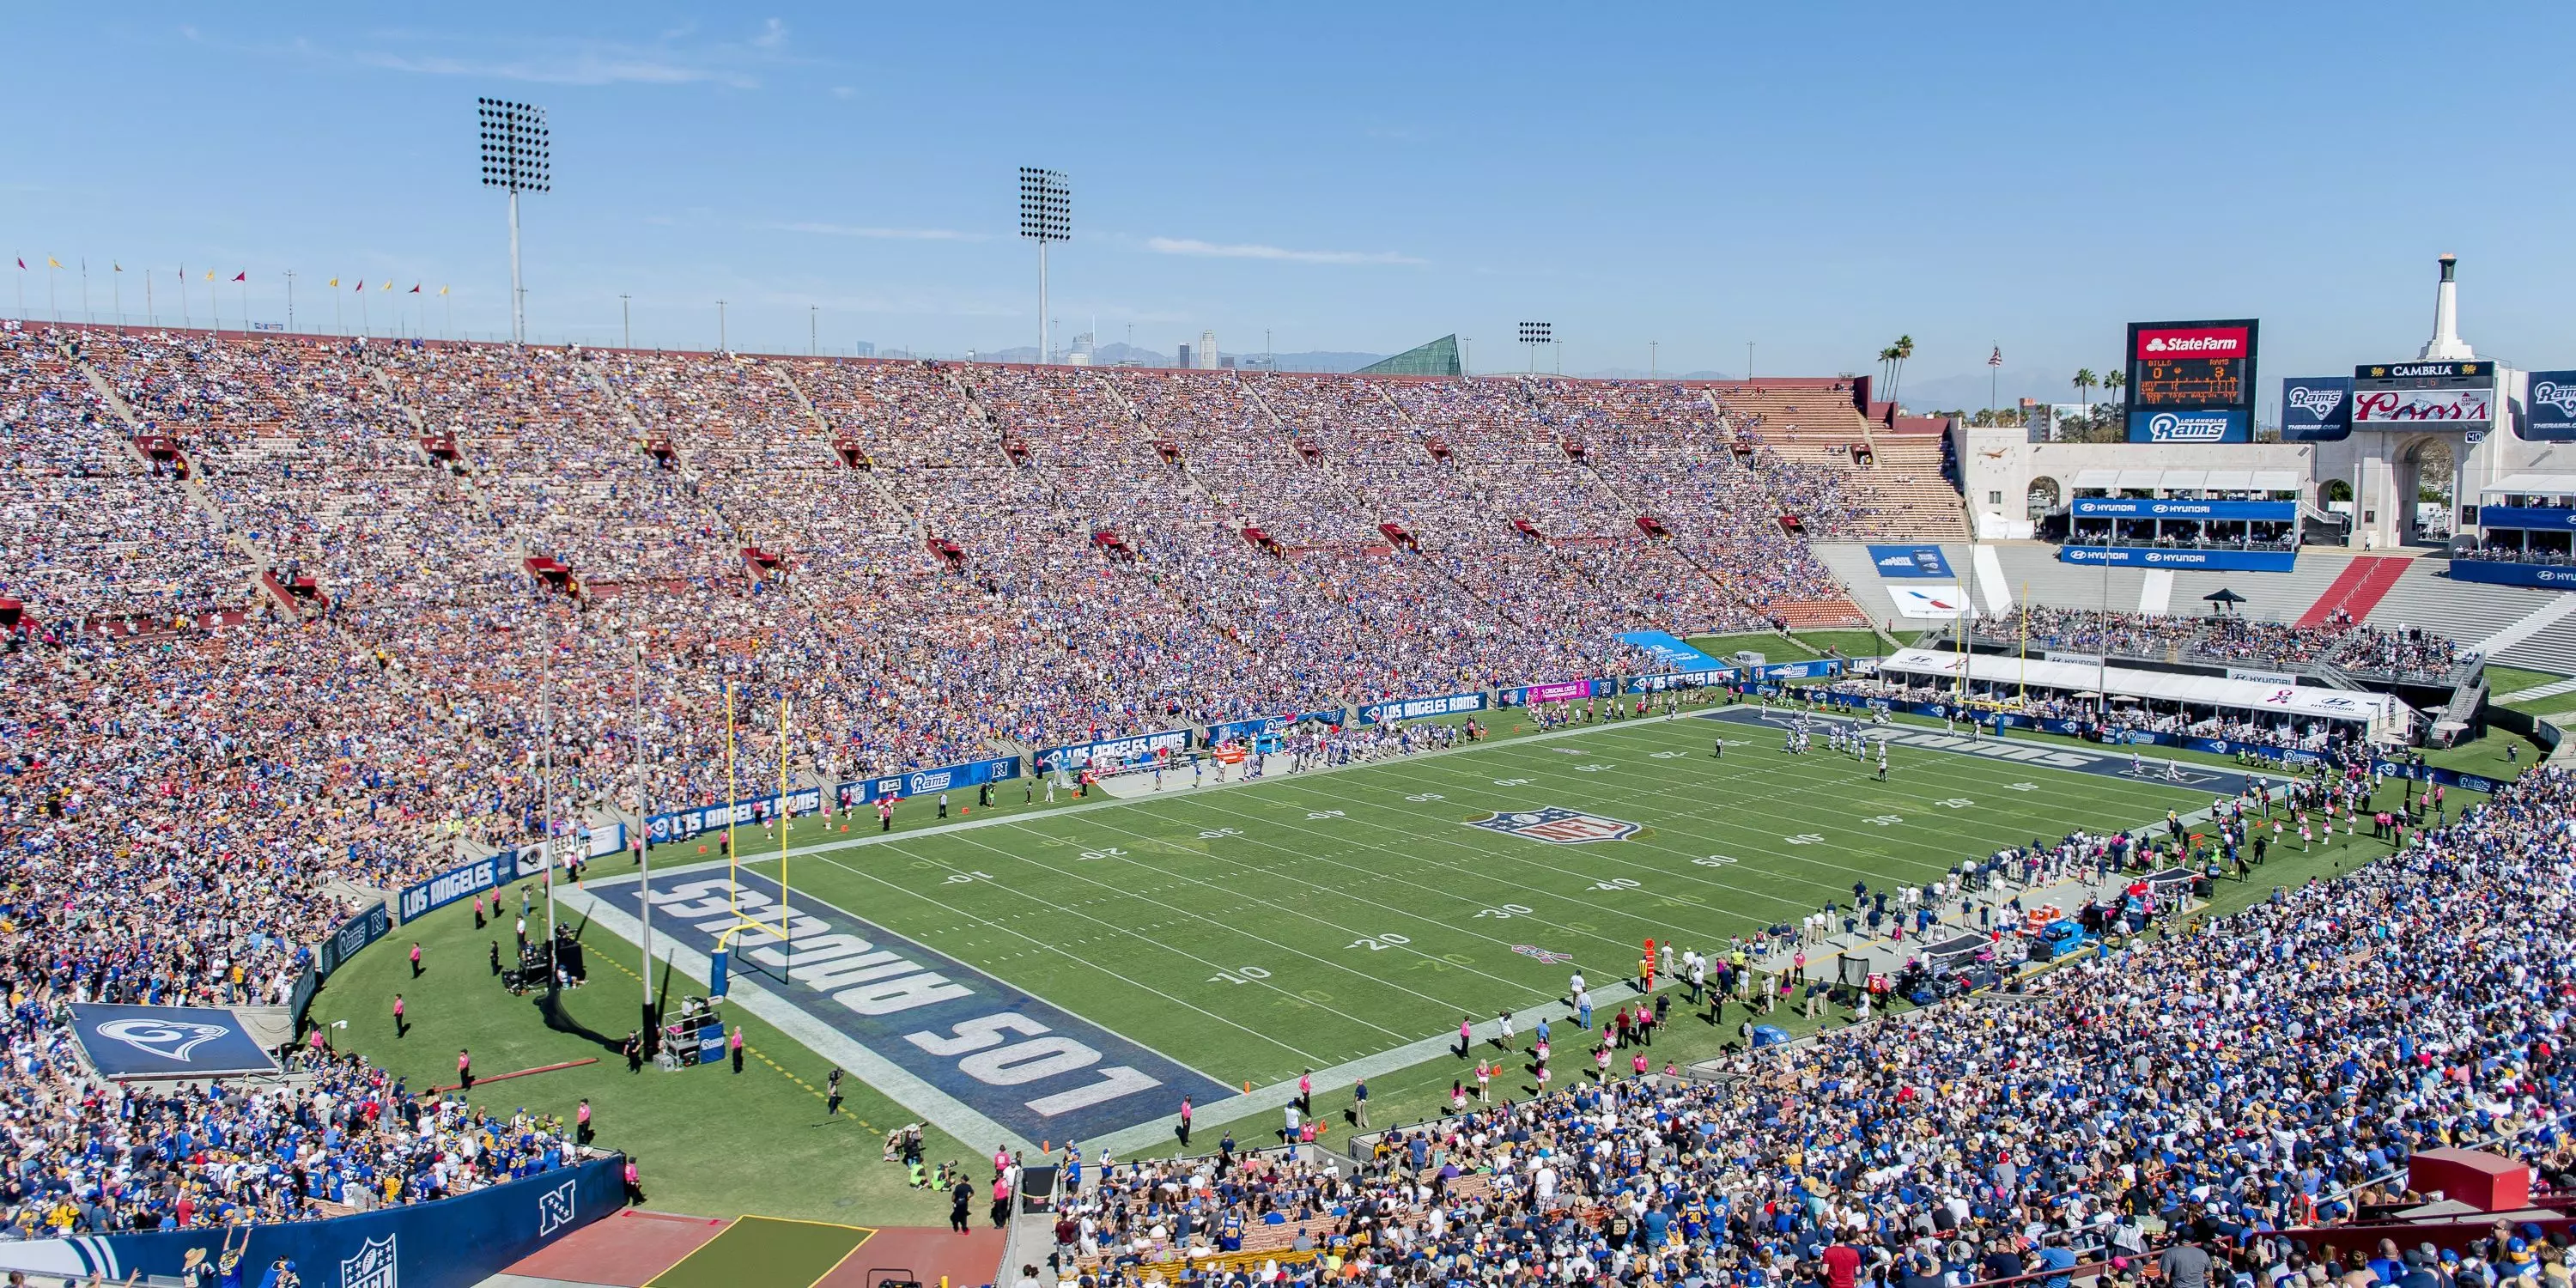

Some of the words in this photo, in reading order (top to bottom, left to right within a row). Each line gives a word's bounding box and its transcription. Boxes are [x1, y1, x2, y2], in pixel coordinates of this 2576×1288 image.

[2392, 365, 2452, 376] CAMBRIA
[2289, 386, 2342, 408] Rams
[2356, 392, 2487, 420] Coors
[2149, 413, 2227, 442] Rams
[2468, 432, 2482, 441] 40
[2170, 505, 2210, 513] HYUNDAI
[2087, 551, 2129, 560] HYUNDAI
[2163, 554, 2205, 562] HYUNDAI
[2065, 659, 2101, 667] HYUNDAI
[2250, 676, 2291, 686] HYUNDAI
[1383, 704, 1403, 720] LOS
[1405, 698, 1448, 716] ANGELES
[1449, 692, 1479, 711] RAMS
[2310, 703, 2355, 713] HYUNDAI
[1092, 736, 1149, 758] ANGELES
[1150, 732, 1187, 751] RAMS
[1860, 728, 2104, 767] RAMS
[2283, 748, 2317, 765] Rams
[910, 772, 951, 793] Rams
[1492, 777, 1531, 787] 40
[1404, 793, 1446, 803] 50
[1935, 797, 1975, 810] 20
[1308, 809, 1346, 821] 40
[1861, 814, 1904, 826] 30
[1199, 827, 1244, 840] 30
[1516, 817, 1628, 841] NFL
[1783, 832, 1826, 846] 40
[1079, 848, 1129, 860] 20
[1690, 854, 1740, 867] 50
[946, 869, 994, 885] 10
[1595, 877, 1642, 892] 40
[404, 887, 428, 918] LOS
[430, 861, 494, 908] ANGELES
[1483, 903, 1534, 920] 30
[338, 926, 366, 963] Rams
[631, 877, 976, 1016] ANGELES
[1354, 932, 1412, 951] 20
[1214, 965, 1273, 985] 10
[903, 1012, 1163, 1117] LOS
[539, 1179, 575, 1236] N
